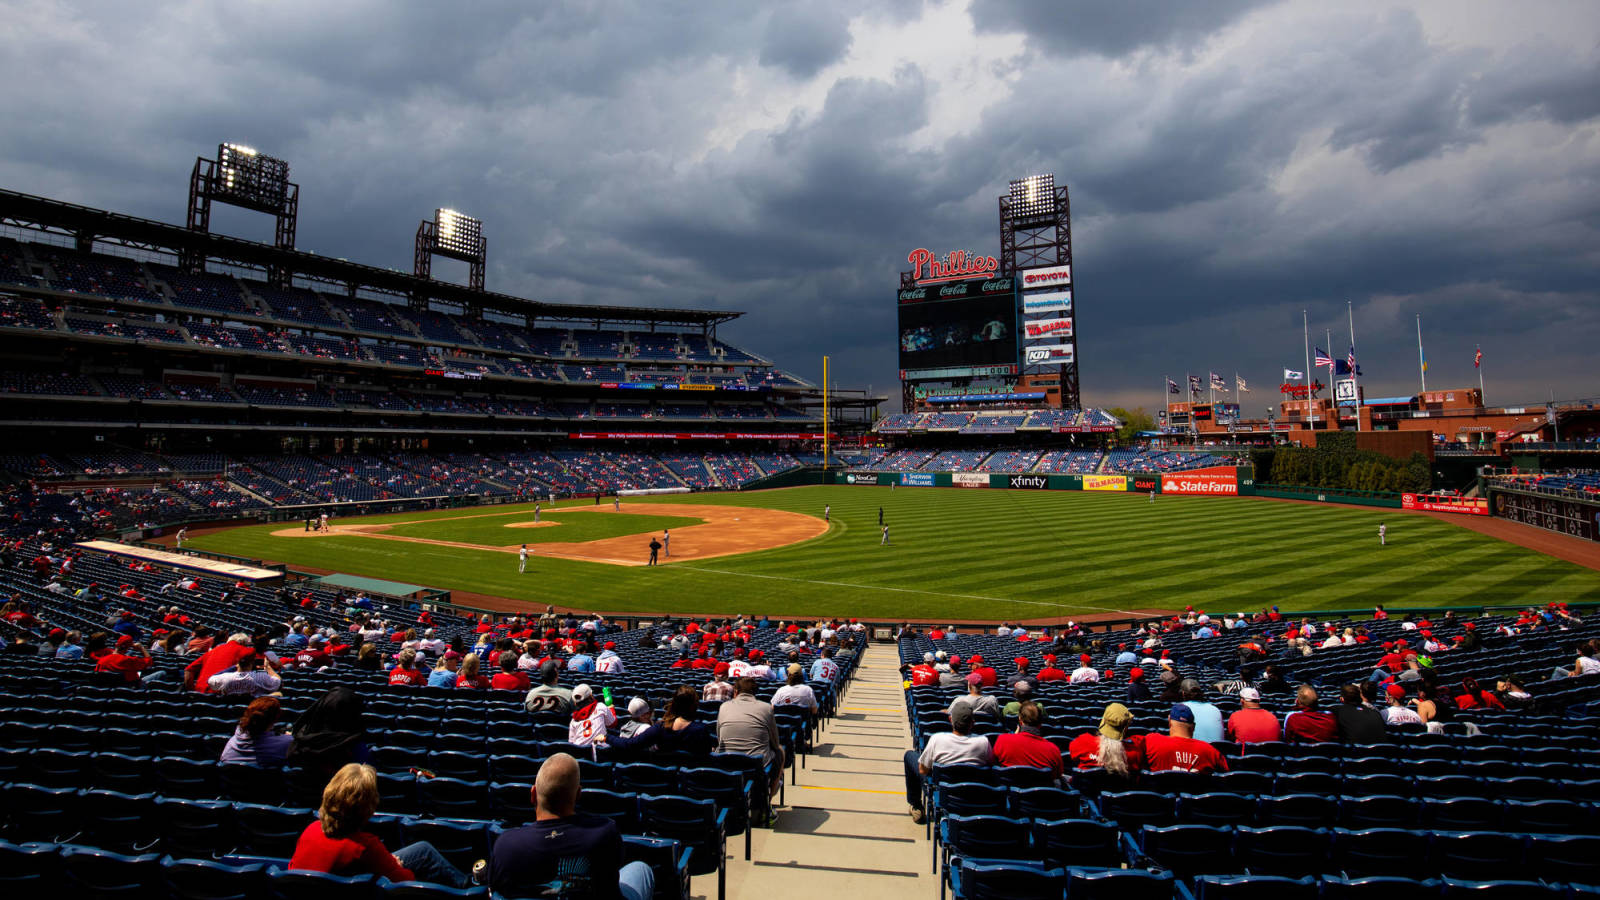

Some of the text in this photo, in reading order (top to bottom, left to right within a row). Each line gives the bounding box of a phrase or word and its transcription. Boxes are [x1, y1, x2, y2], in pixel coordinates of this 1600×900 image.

[908, 248, 998, 280] Phillies
[1036, 271, 1068, 282] TOYOTA
[1011, 476, 1051, 488] xfinity
[598, 662, 610, 672] 17
[733, 668, 741, 678] 6
[820, 666, 836, 681] 32
[532, 695, 561, 712] 22
[1175, 751, 1199, 765] RUIZ
